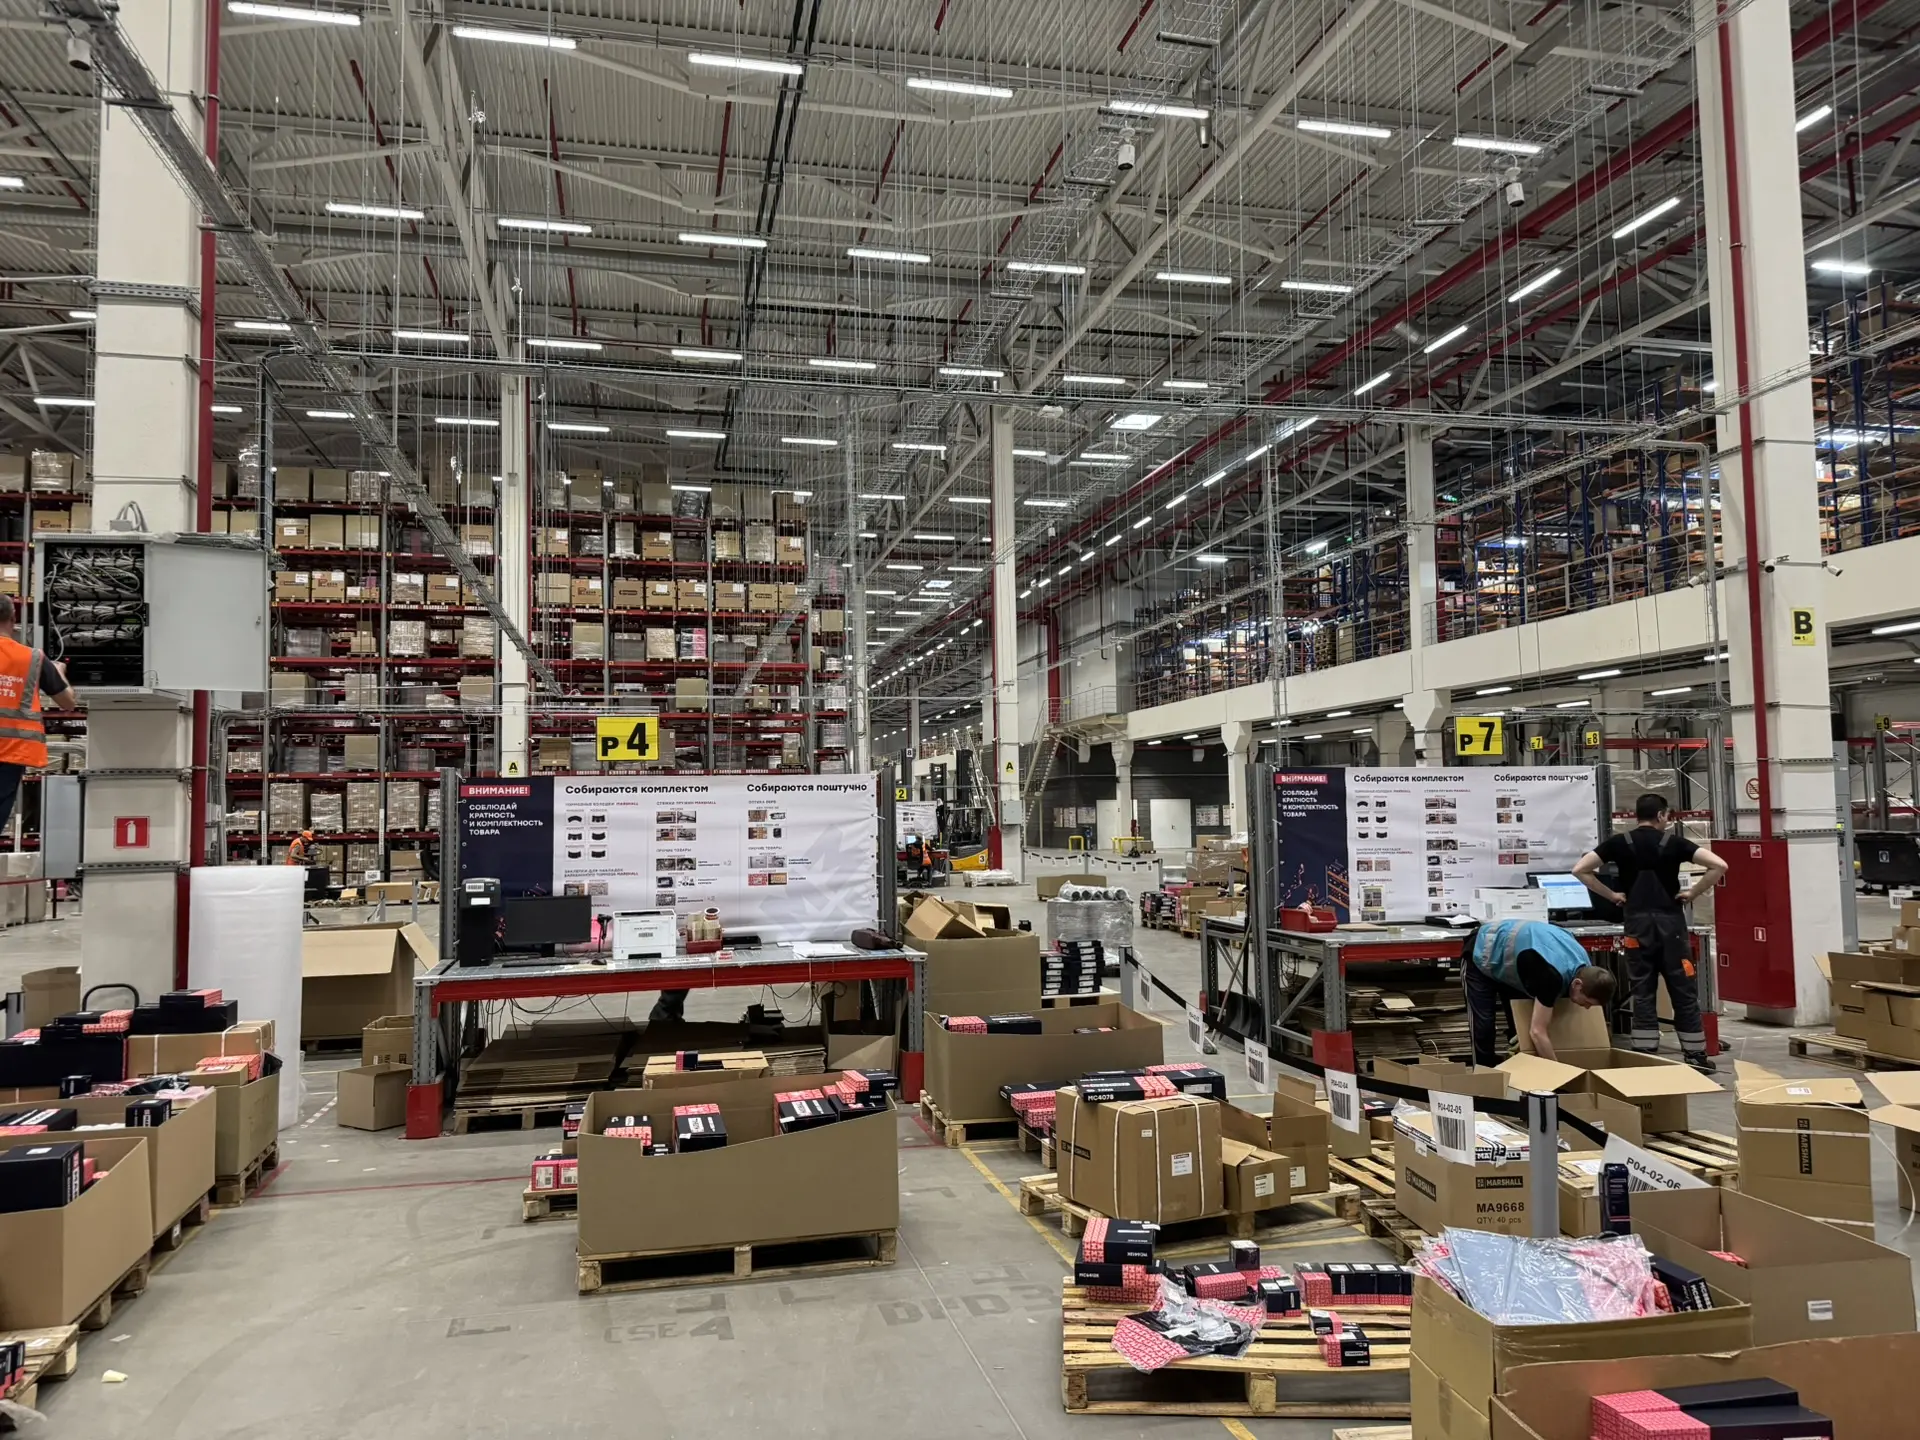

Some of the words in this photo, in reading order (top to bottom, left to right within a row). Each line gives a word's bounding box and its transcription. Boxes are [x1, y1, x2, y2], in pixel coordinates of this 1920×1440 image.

[1794, 611, 1813, 634] B
[1883, 718, 1890, 730] 9
[601, 737, 619, 757] P
[627, 723, 649, 756] 4
[1460, 735, 1473, 751] P
[1479, 722, 1496, 751] 7
[1592, 733, 1598, 744] 8
[1536, 738, 1541, 748] 7
[509, 762, 518, 771] A
[1006, 762, 1014, 771] A
[1354, 775, 1409, 784] Собираются
[1411, 774, 1464, 782] комплектом
[1494, 774, 1547, 784] Собираются
[1548, 774, 1589, 783] поштучно
[468, 786, 528, 795] ВНИМАНИЕ!
[565, 785, 638, 796] Собираются
[641, 785, 709, 794] комплектом
[747, 783, 814, 795] Собираются
[816, 783, 868, 794] поштучно
[898, 789, 905, 799] 2
[1282, 788, 1318, 796] СОБЛЮДАЙ
[469, 802, 517, 811] СОБЛЮДАЙ
[979, 855, 985, 863] 3
[1437, 1101, 1462, 1114] P04-02-05
[1626, 1157, 1682, 1189] P04-02-06
[1411, 1174, 1436, 1198] MARSHALL
[1486, 1178, 1522, 1187] MARSHALL
[1476, 1202, 1525, 1213] MA9668
[1477, 1217, 1494, 1225] QTY:
[1508, 1217, 1522, 1225] pcs
